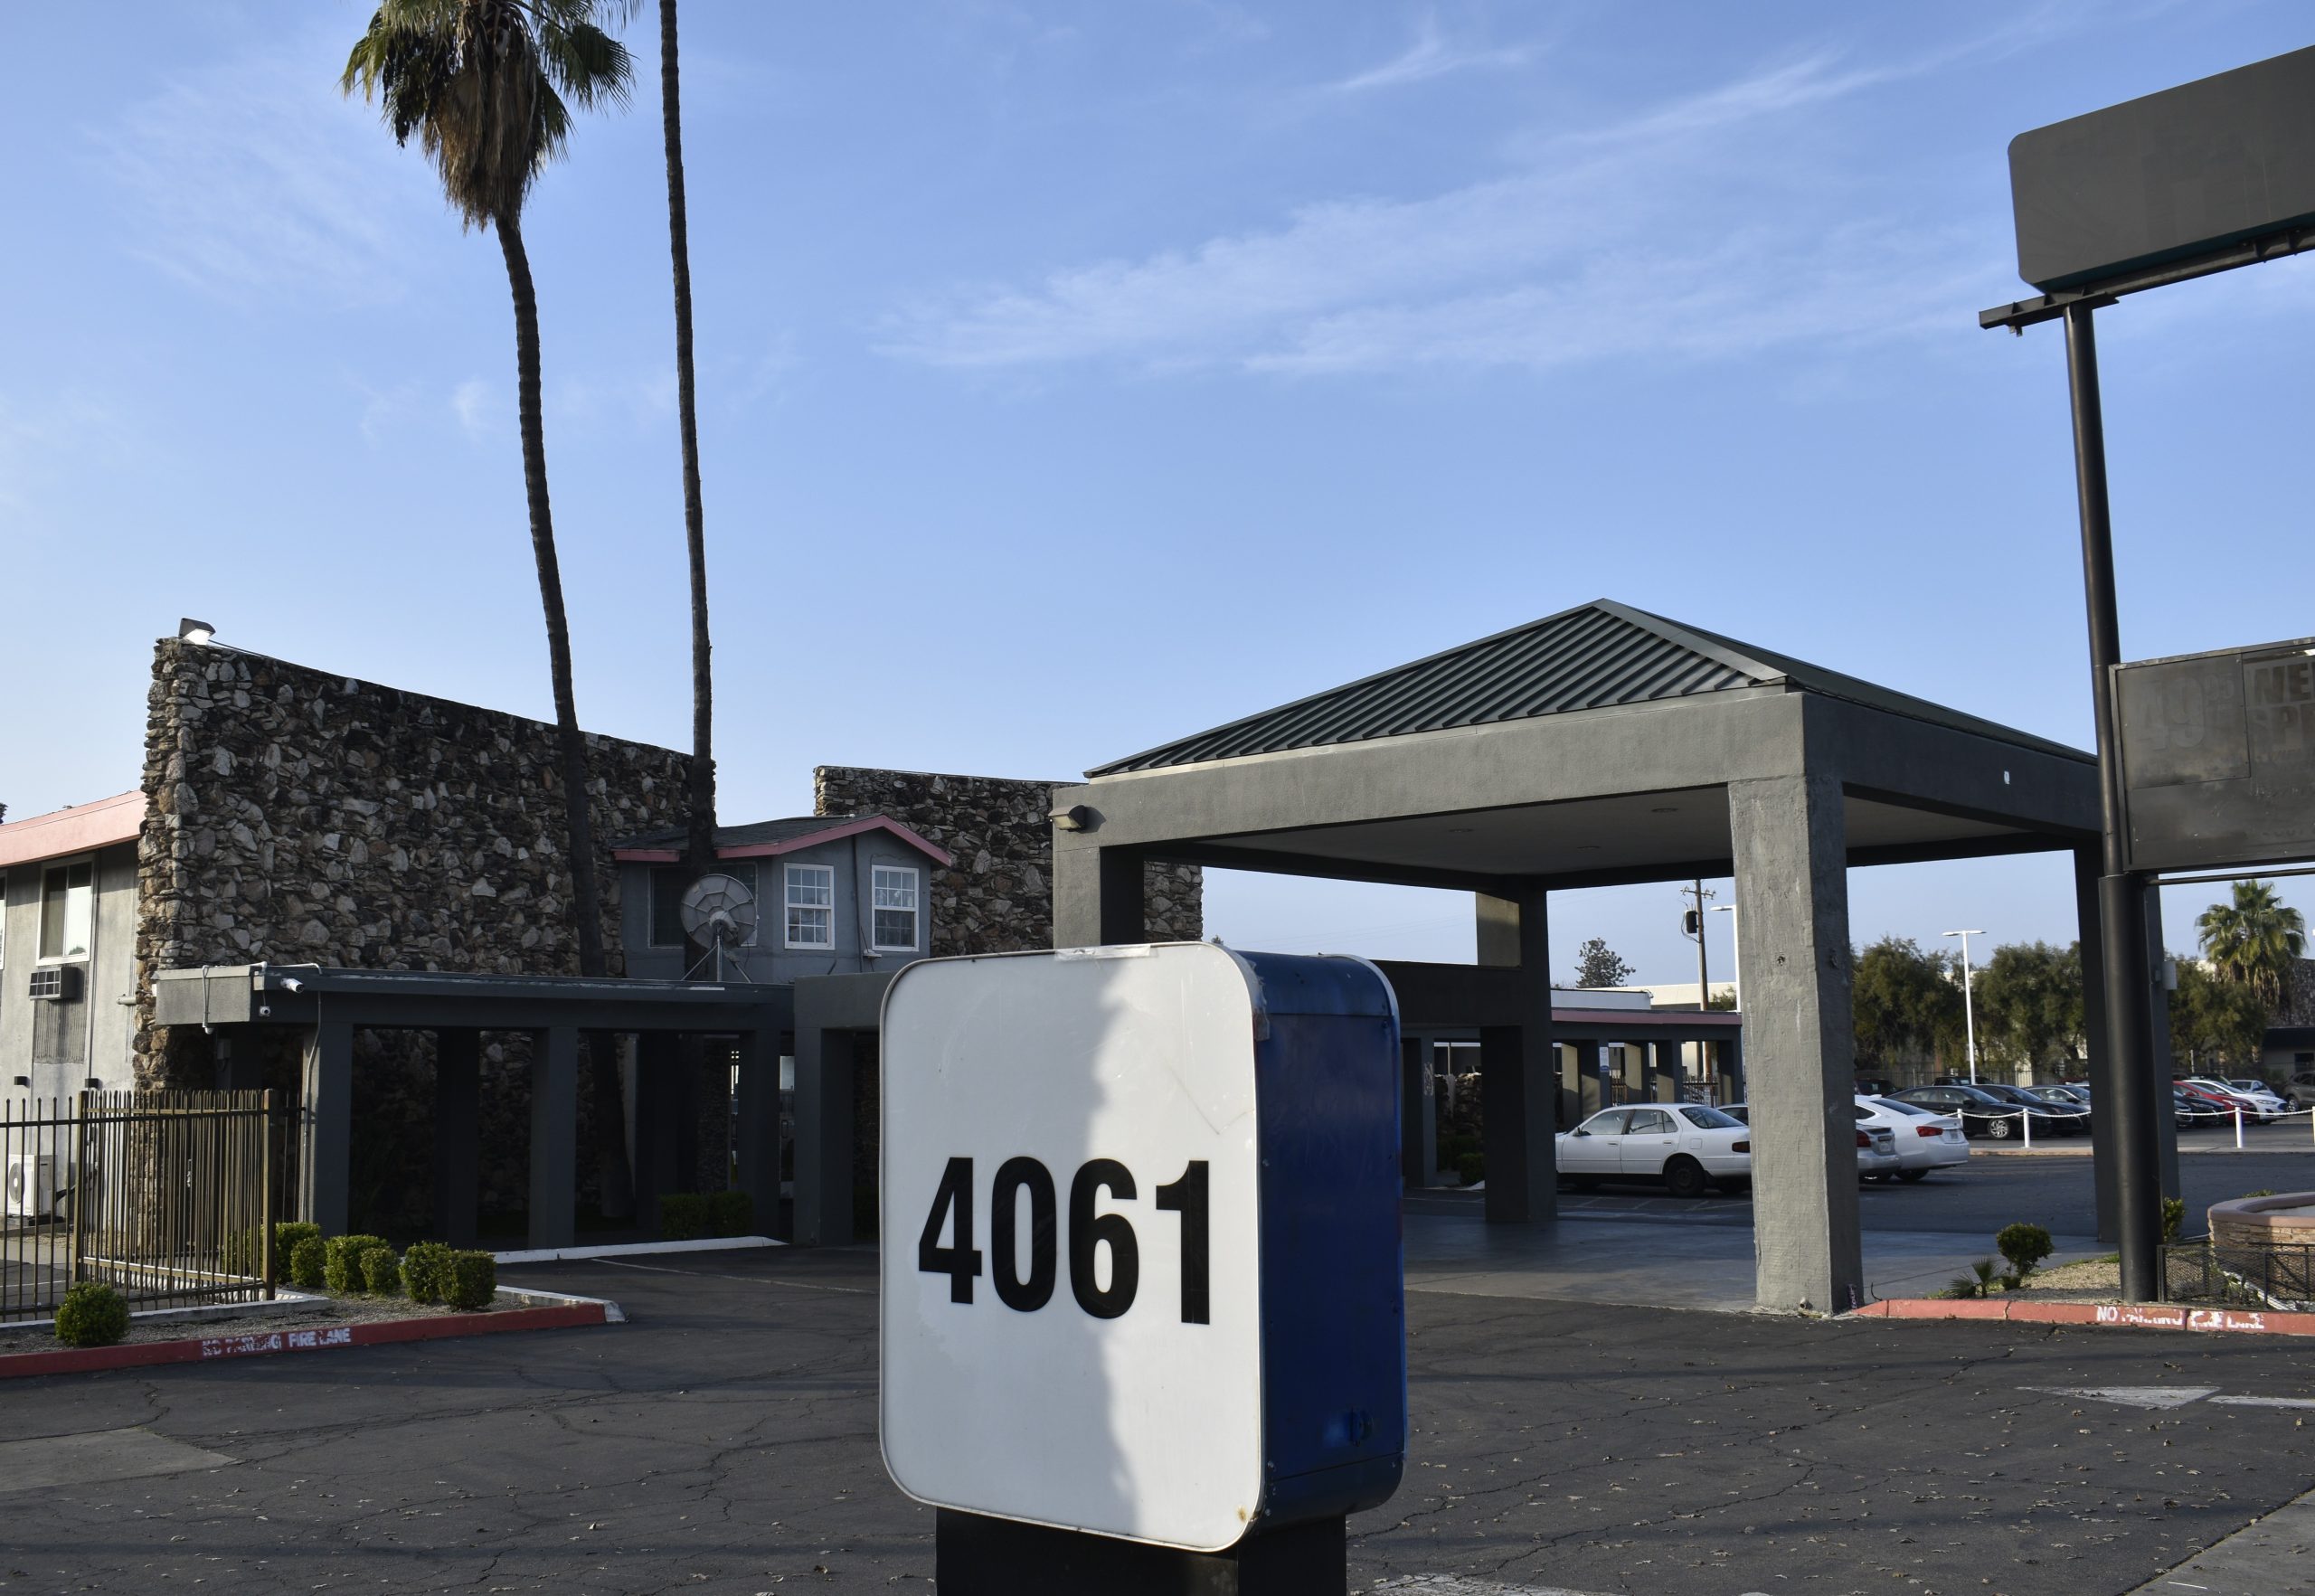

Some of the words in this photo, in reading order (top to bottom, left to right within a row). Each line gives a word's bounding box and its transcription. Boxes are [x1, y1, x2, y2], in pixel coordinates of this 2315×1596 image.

[919, 1156, 1211, 1325] 4061
[2096, 1306, 2118, 1322] NO
[288, 1331, 317, 1347] FIRE
